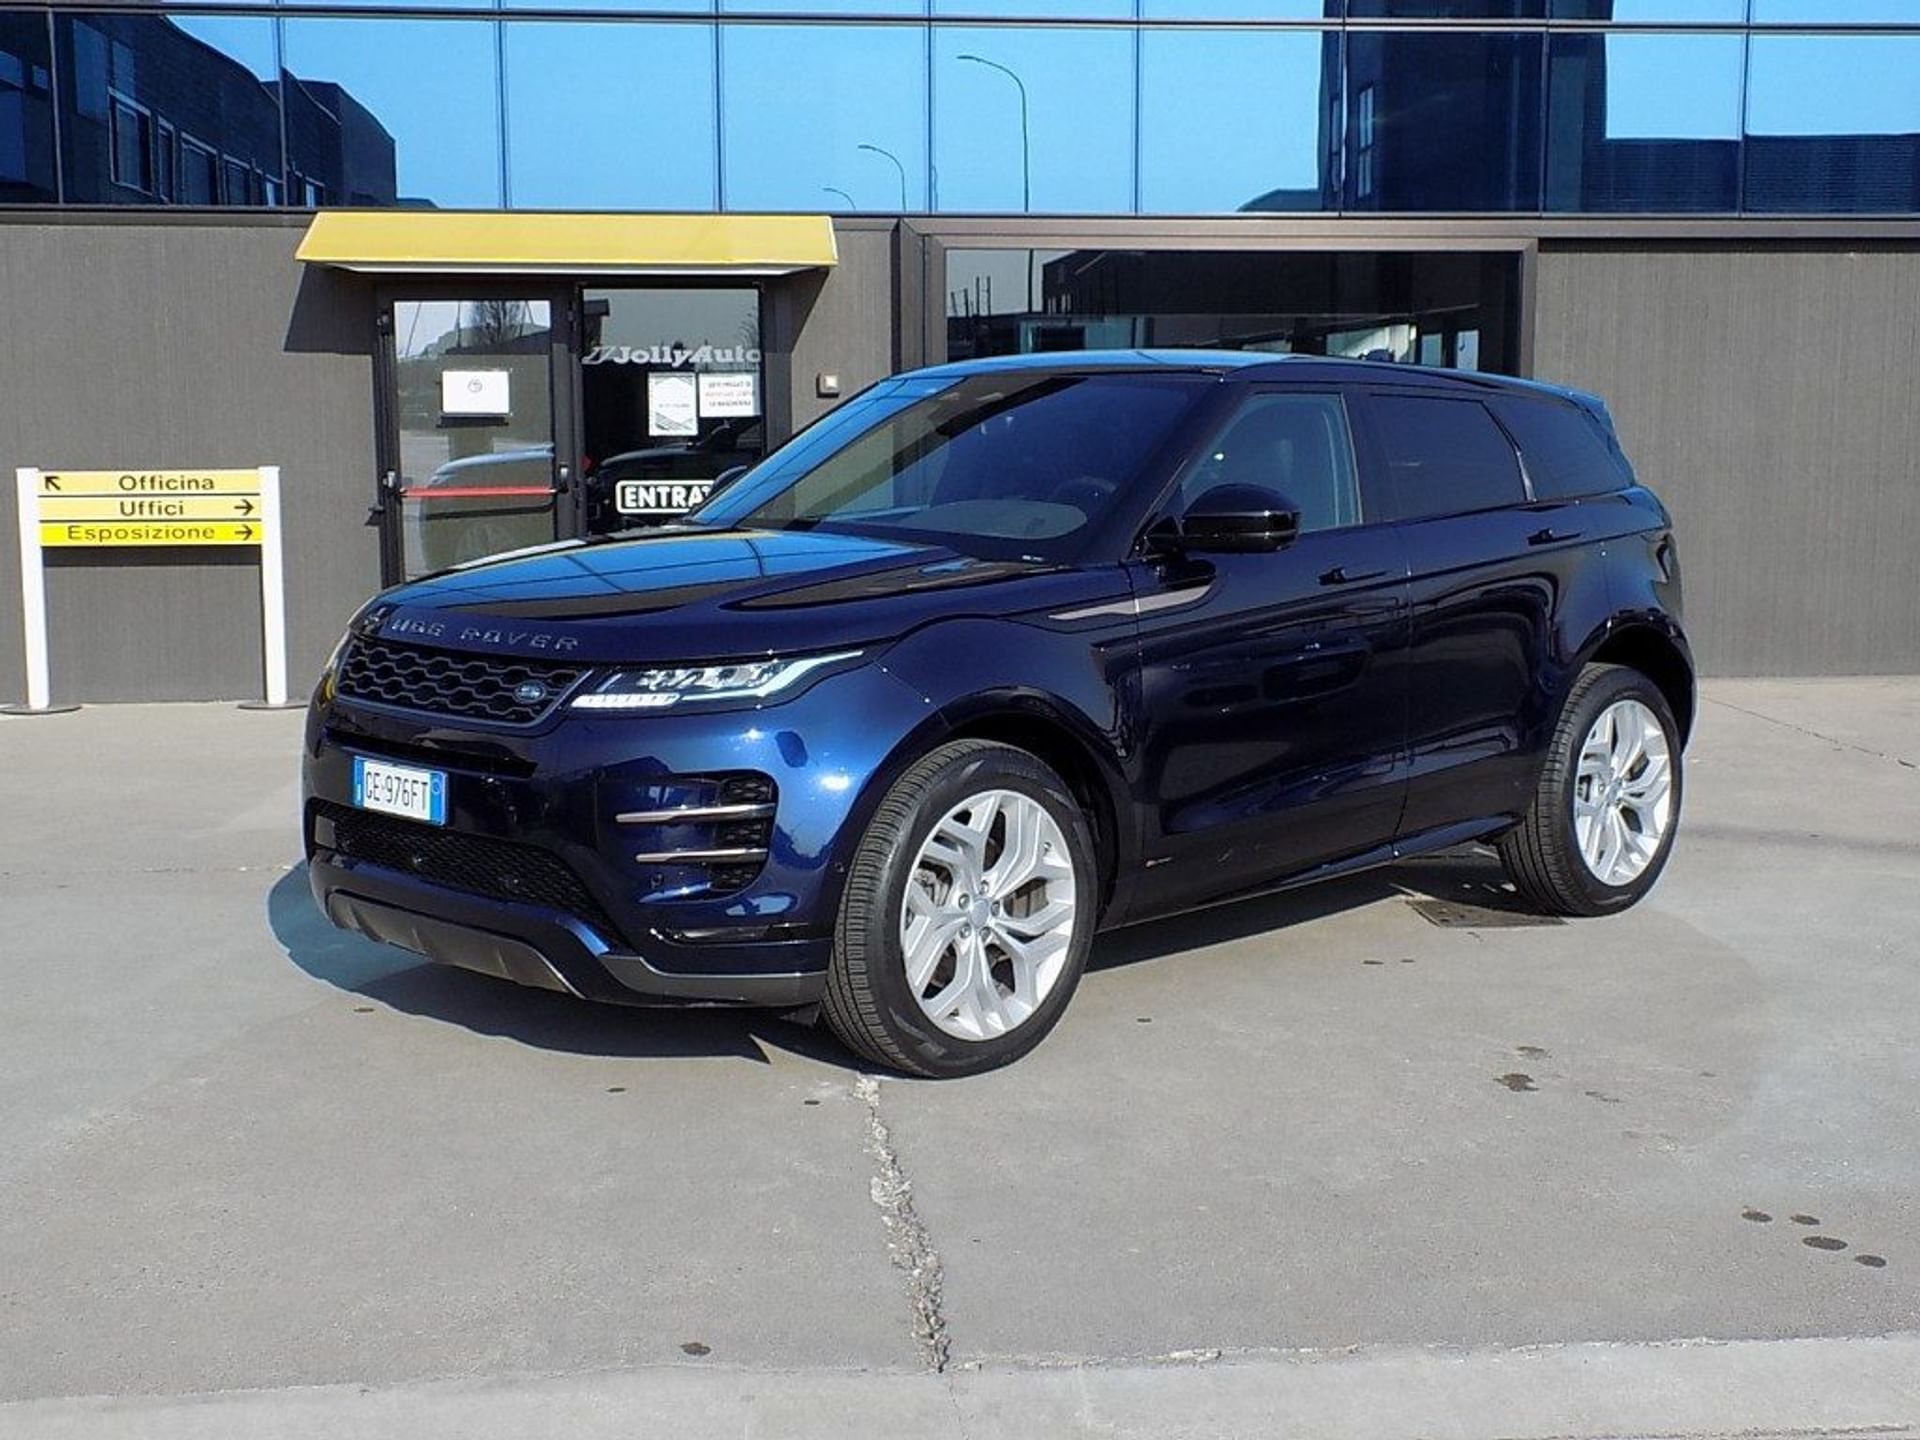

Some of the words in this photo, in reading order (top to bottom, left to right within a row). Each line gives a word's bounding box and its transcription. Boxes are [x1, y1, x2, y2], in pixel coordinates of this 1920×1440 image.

[613, 345, 761, 367] JollyAuto
[118, 475, 215, 491] Officina
[119, 501, 184, 516] Uffici
[67, 525, 215, 542] Esposizione
[461, 628, 578, 650] ROVER
